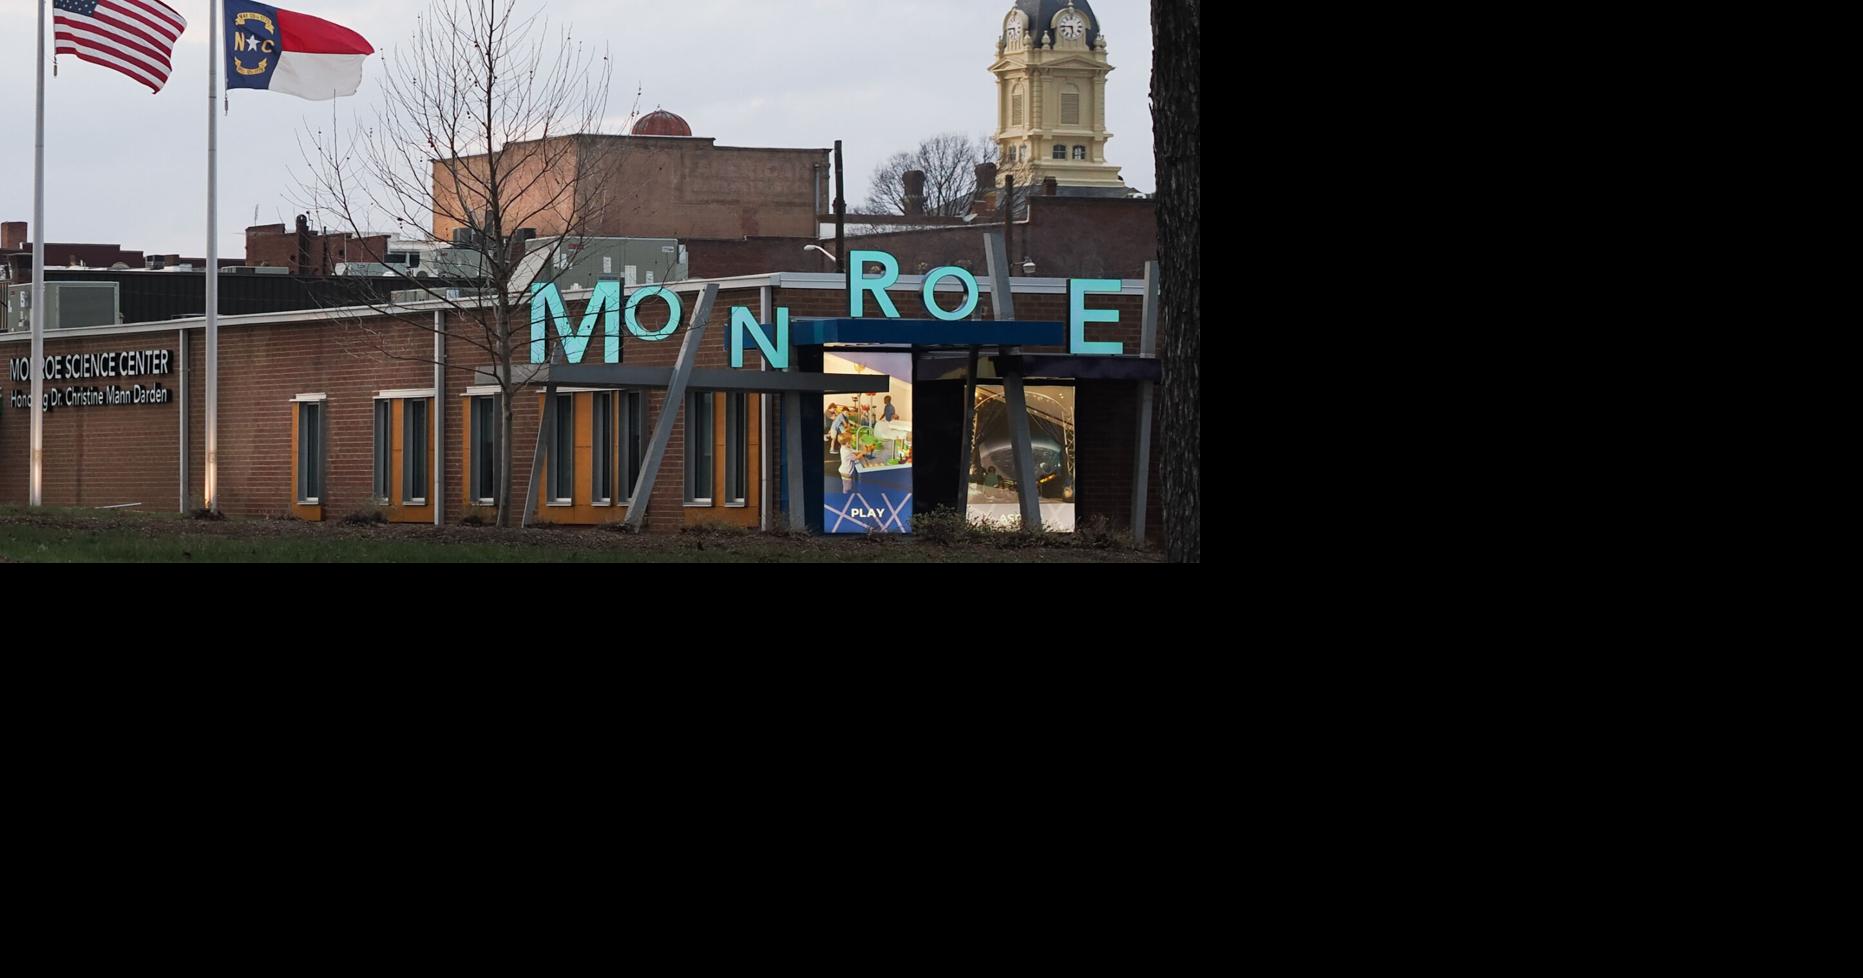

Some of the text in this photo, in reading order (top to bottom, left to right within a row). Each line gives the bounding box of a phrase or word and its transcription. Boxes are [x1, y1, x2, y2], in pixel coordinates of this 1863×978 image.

[9, 349, 169, 381] MOOE SCIENCE CENTER
[10, 382, 167, 412] Honog Dr. Christine Mann Darden
[850, 507, 885, 518] PLAY
